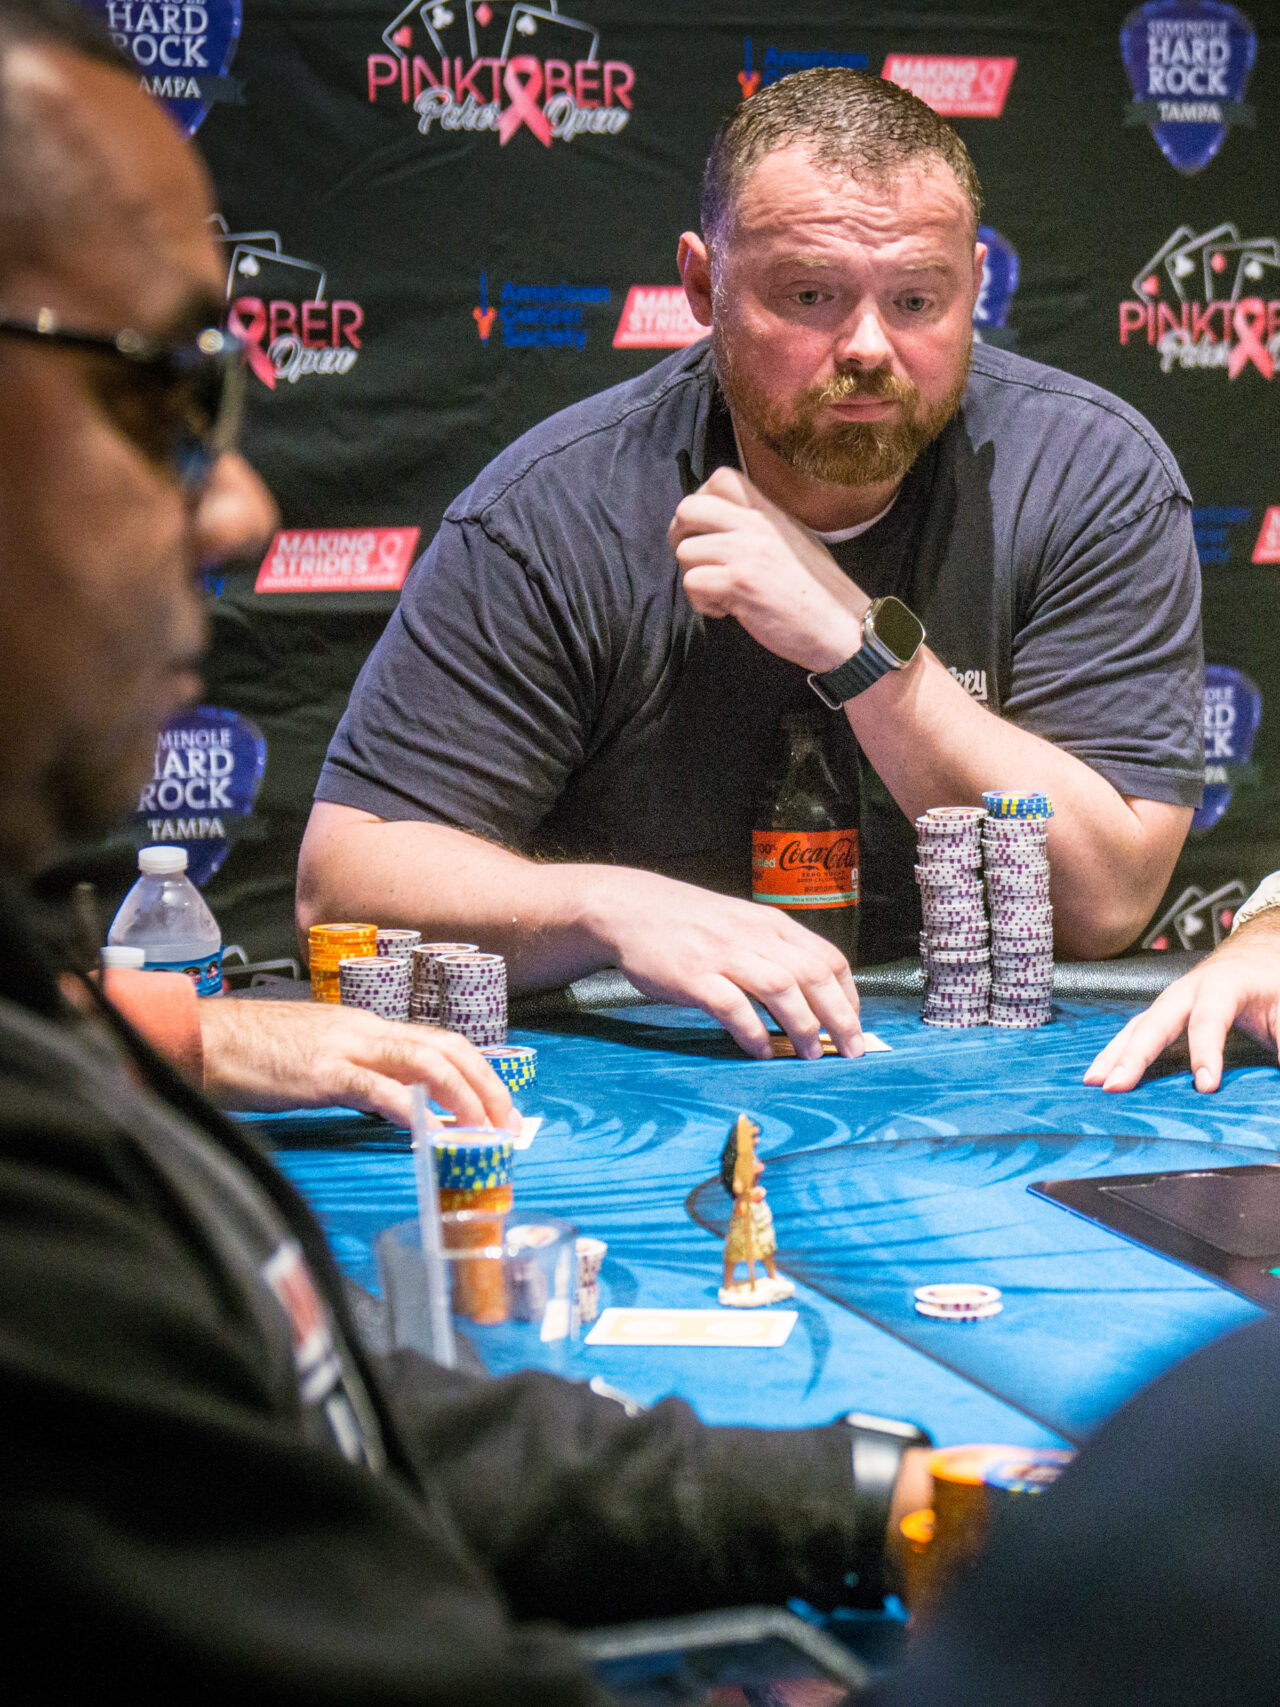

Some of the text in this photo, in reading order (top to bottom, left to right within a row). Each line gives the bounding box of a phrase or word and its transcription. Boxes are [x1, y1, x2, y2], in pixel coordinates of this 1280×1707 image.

[106, 2, 209, 35] HARD
[1147, 37, 1232, 66] HARD
[367, 53, 637, 110] PINKTOBER
[890, 59, 977, 82] MAKING
[1147, 66, 1229, 96] ROCK
[139, 75, 201, 98] AMPA
[542, 92, 631, 142] Open
[1157, 101, 1223, 123] TAMPA
[633, 290, 686, 311] MAK
[267, 333, 359, 384] Open
[277, 532, 375, 555] MAKING
[270, 553, 369, 576] STRIDES
[156, 727, 232, 750] MINOLE
[137, 777, 233, 812] ROCK
[147, 816, 226, 841] TAMPA
[779, 838, 855, 871] Coca-Cola
